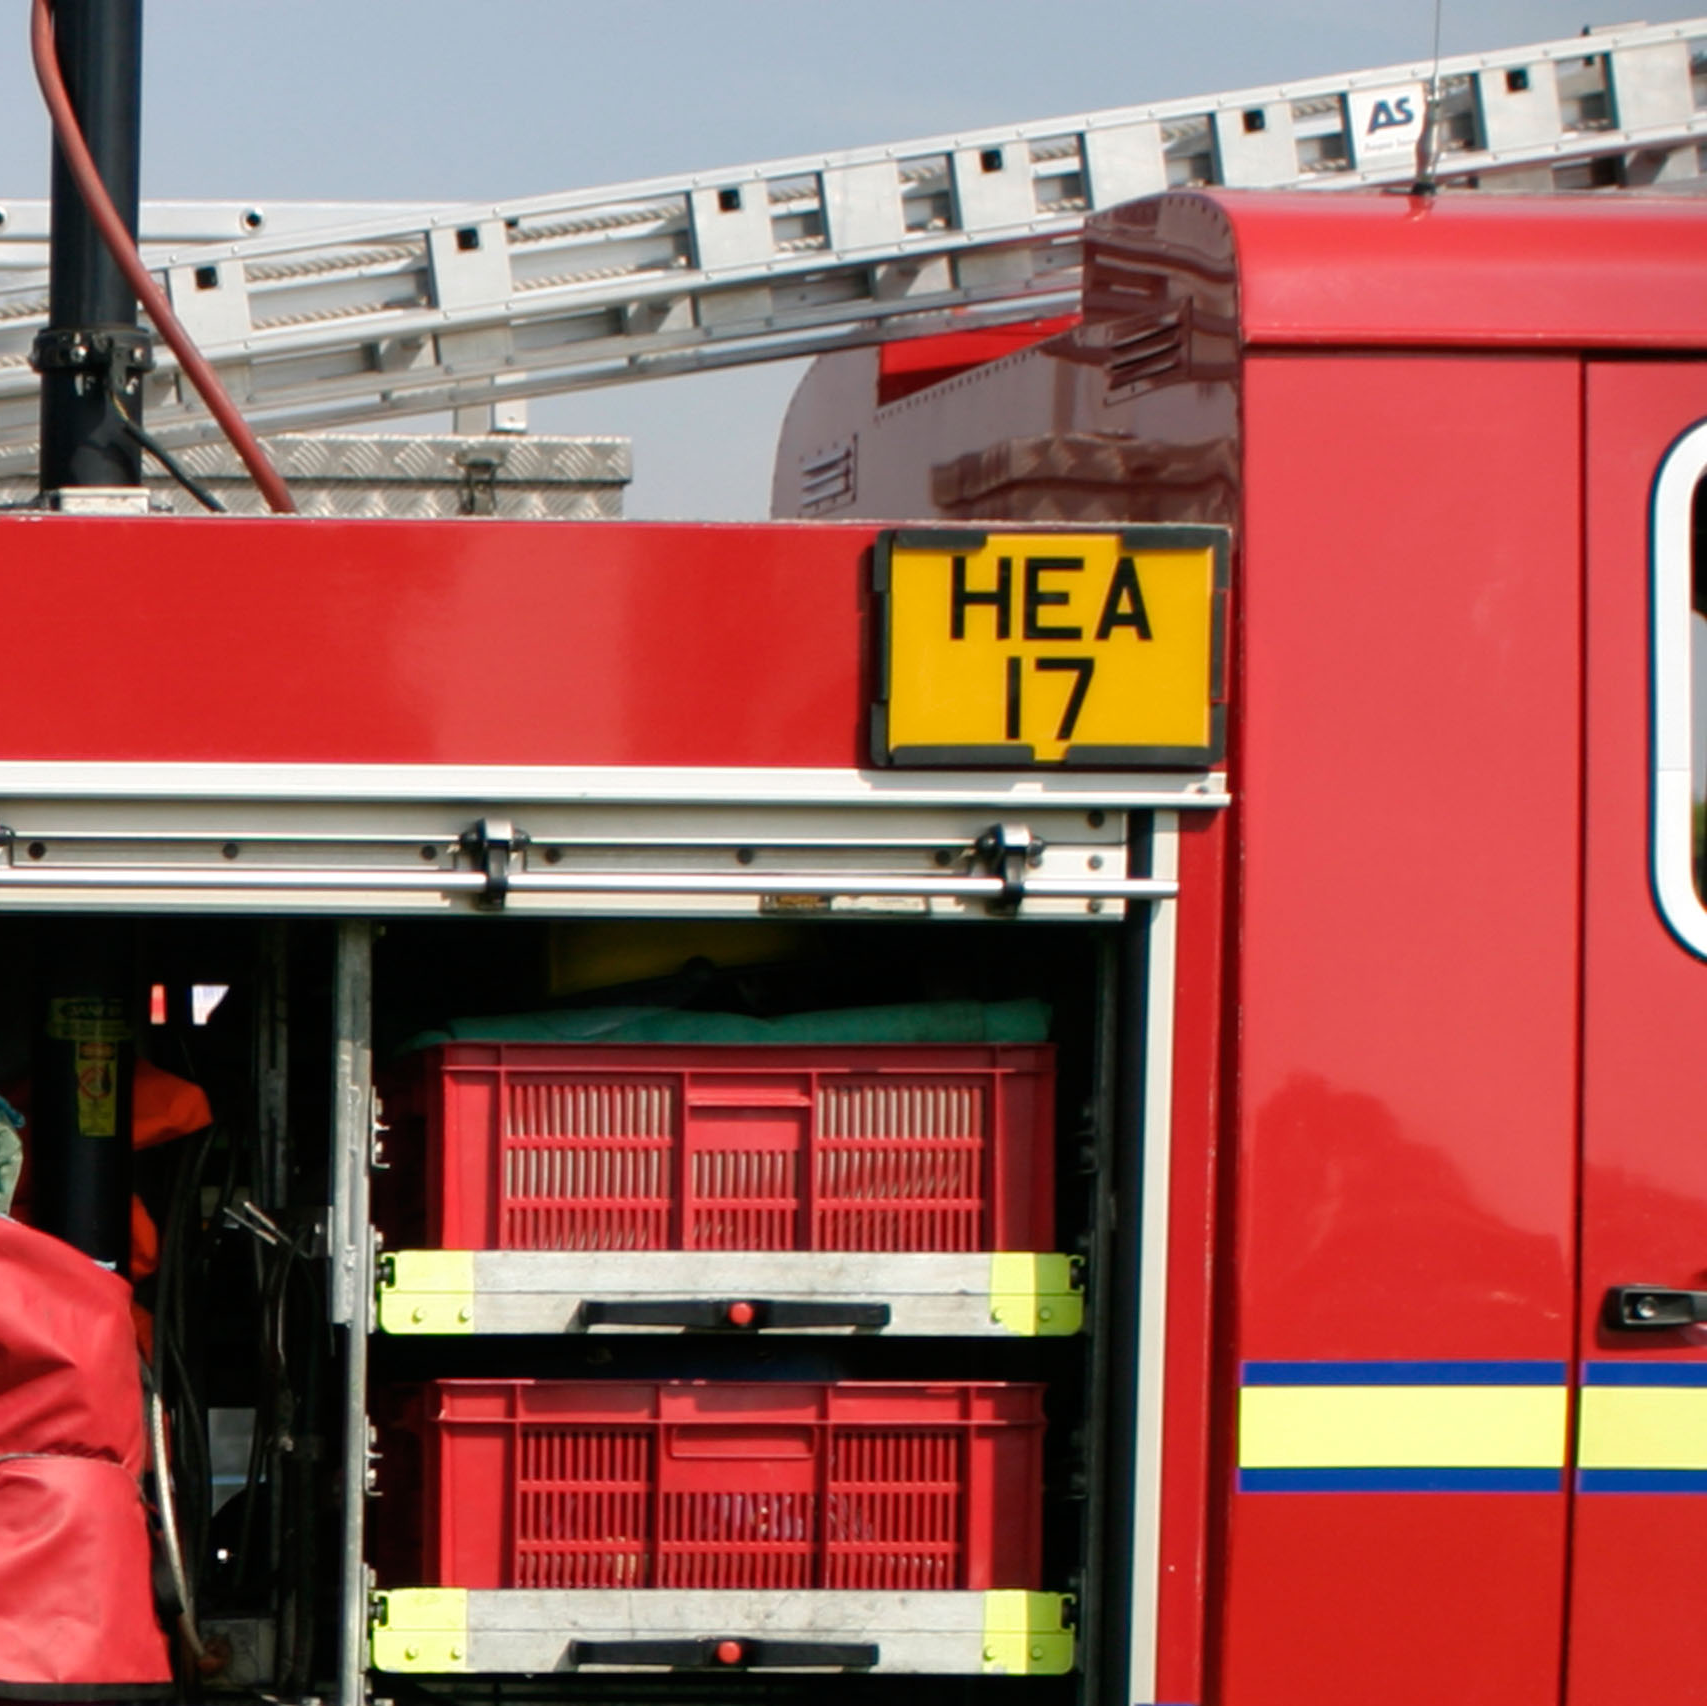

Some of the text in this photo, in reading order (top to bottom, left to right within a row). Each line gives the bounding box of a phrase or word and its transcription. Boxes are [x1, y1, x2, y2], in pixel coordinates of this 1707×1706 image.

[1366, 96, 1415, 135] AS
[951, 556, 1153, 641] HEA
[1005, 656, 1095, 741] 17
